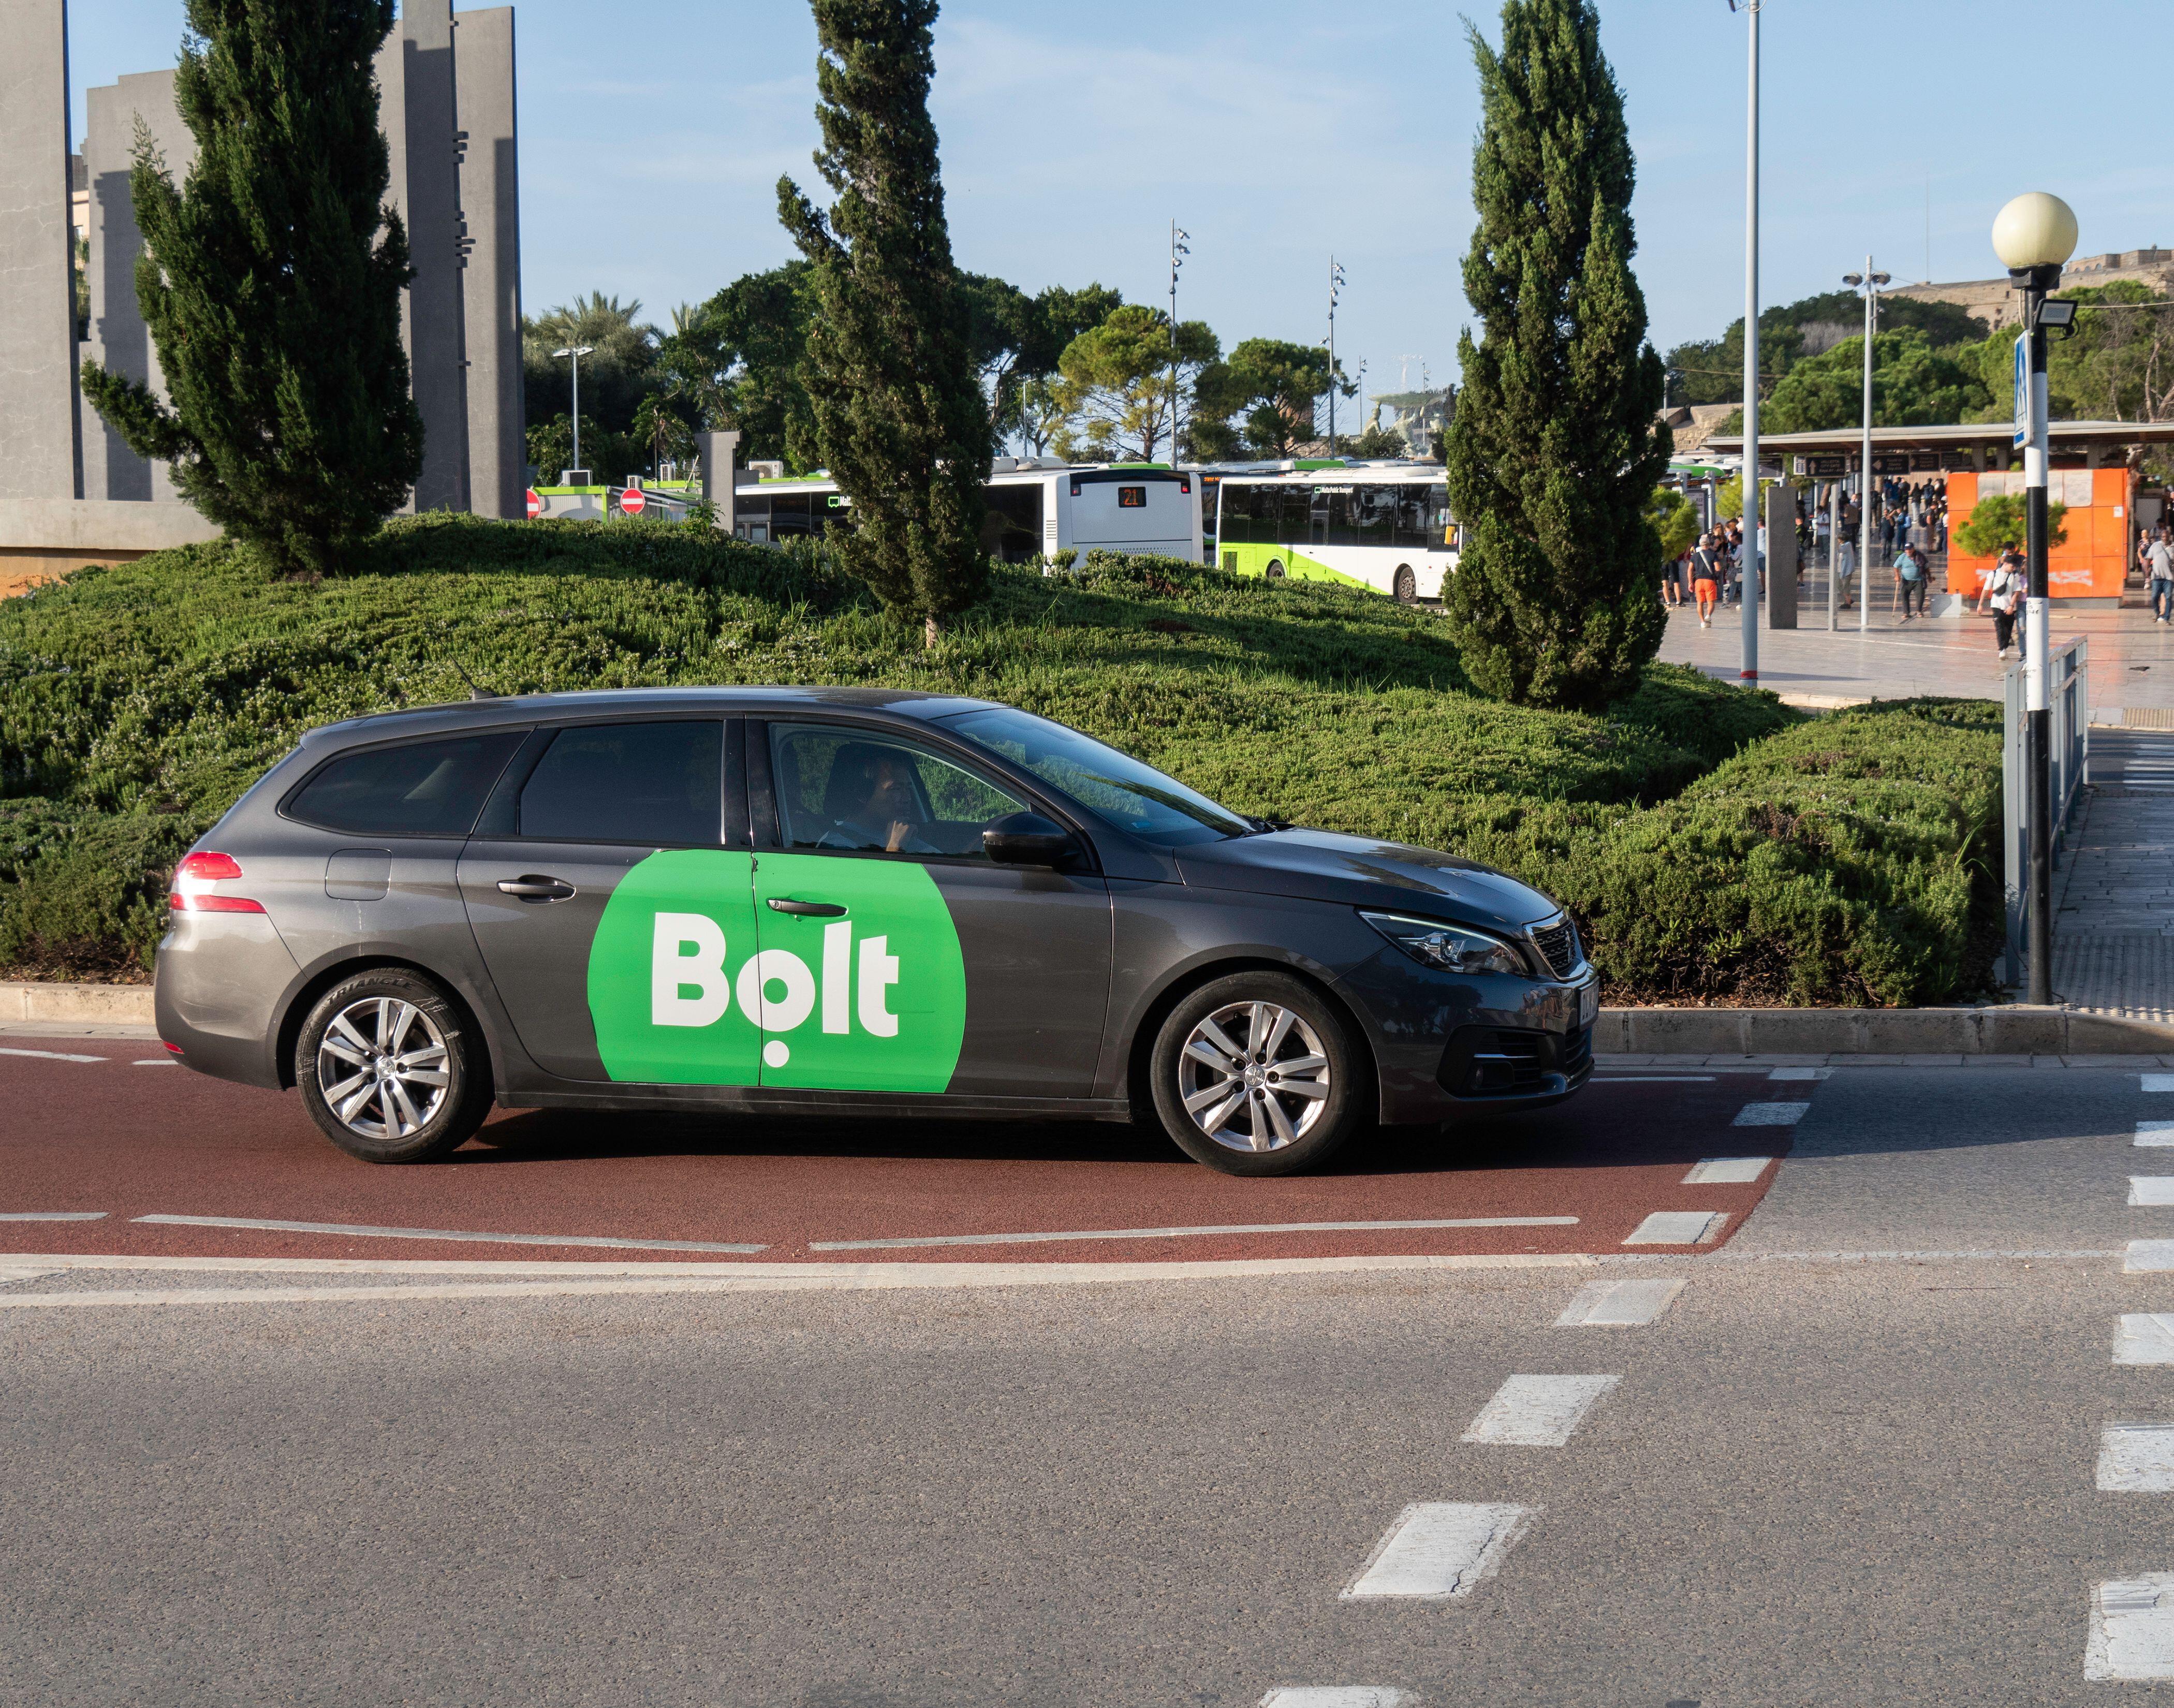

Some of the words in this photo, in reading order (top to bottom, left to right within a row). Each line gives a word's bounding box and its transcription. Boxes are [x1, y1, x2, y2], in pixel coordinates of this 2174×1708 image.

[840, 496, 853, 506] Malt
[1124, 488, 1138, 506] 21
[327, 977, 416, 1005] TRIANGLE
[652, 912, 899, 1068] Bolt
